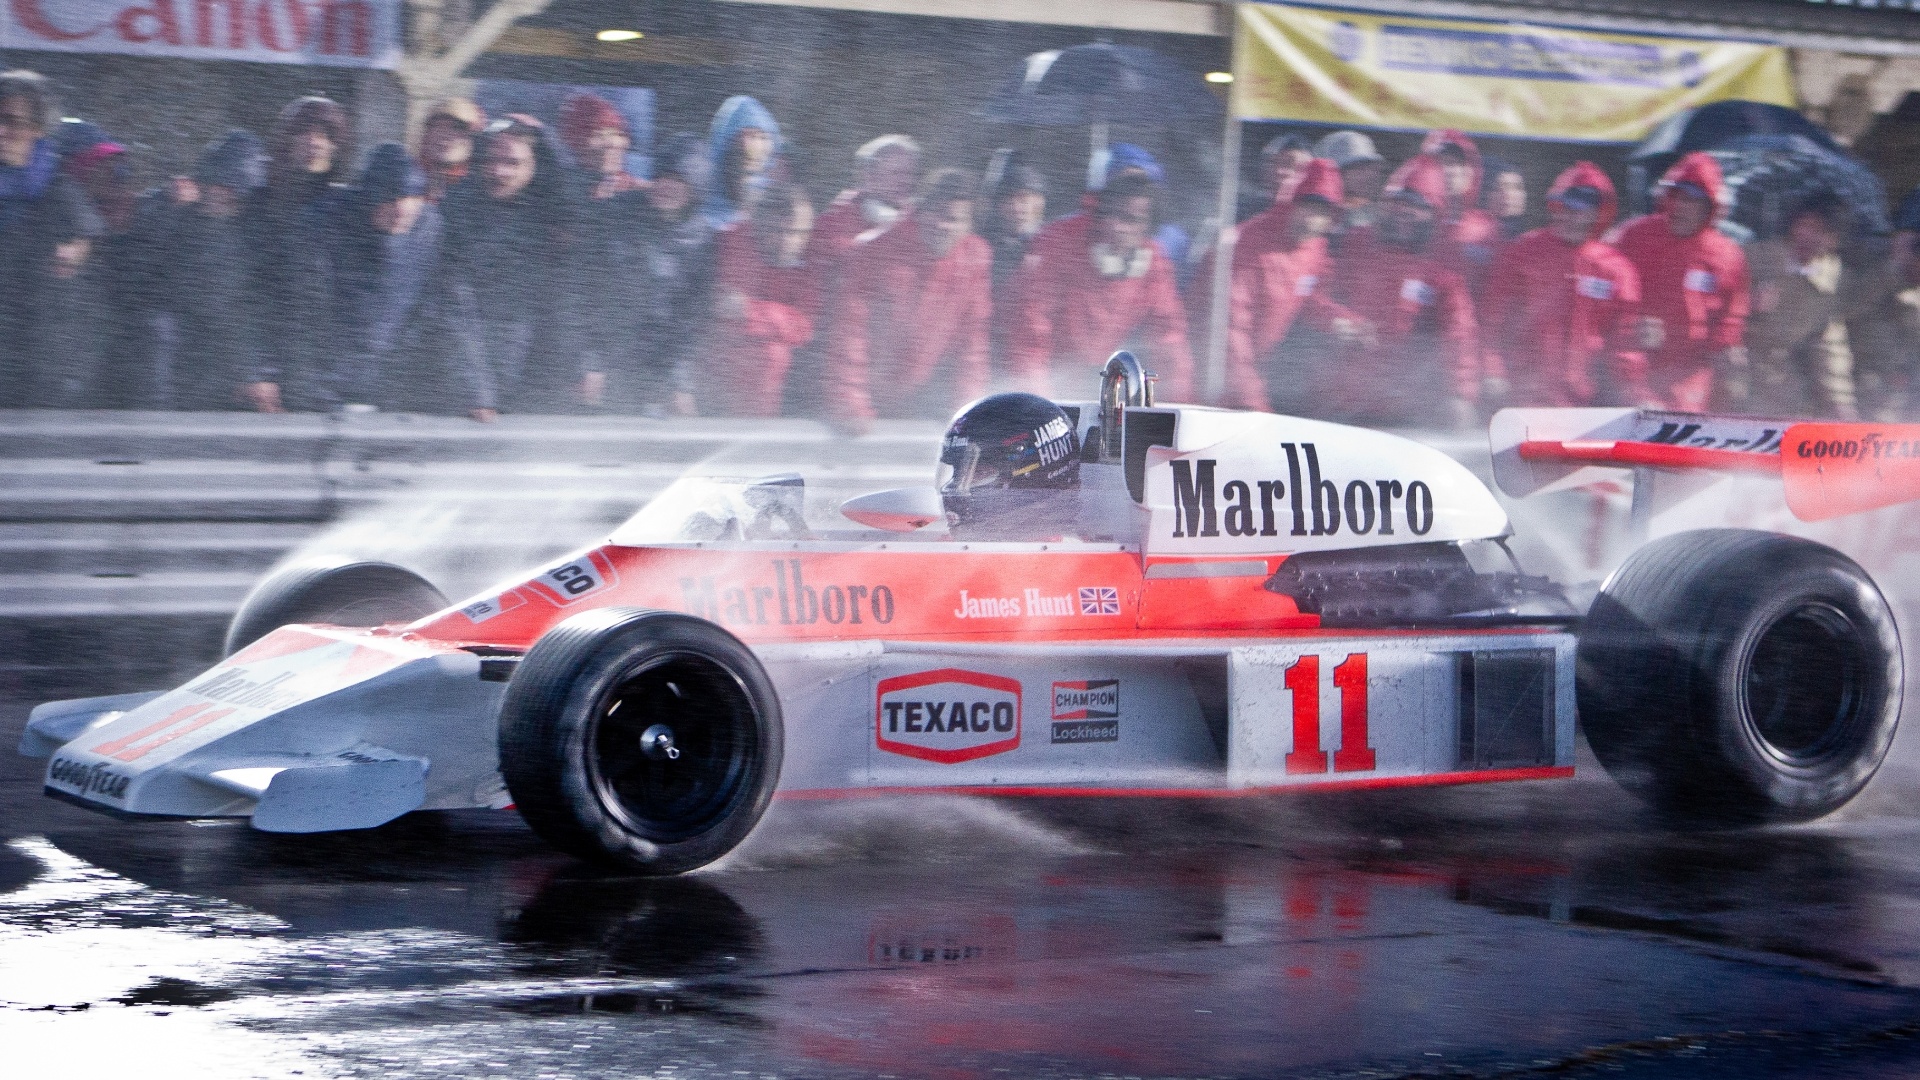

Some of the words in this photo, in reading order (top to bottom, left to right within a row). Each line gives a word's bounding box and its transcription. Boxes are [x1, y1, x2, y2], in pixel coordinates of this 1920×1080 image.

[8, 0, 374, 57] Canon
[1034, 416, 1069, 448] JAMES
[1038, 432, 1073, 466] HUNT
[1169, 443, 1433, 537] Marlboro
[547, 561, 595, 595] CO
[679, 559, 895, 625] Marlboro
[954, 590, 1021, 619] James
[1024, 588, 1075, 617] Hunt
[1055, 691, 1116, 708] CHAMPION
[1284, 653, 1376, 775] 11
[89, 702, 238, 762] 11
[884, 701, 1014, 733] TEXACO
[1053, 724, 1117, 740] Lockheed
